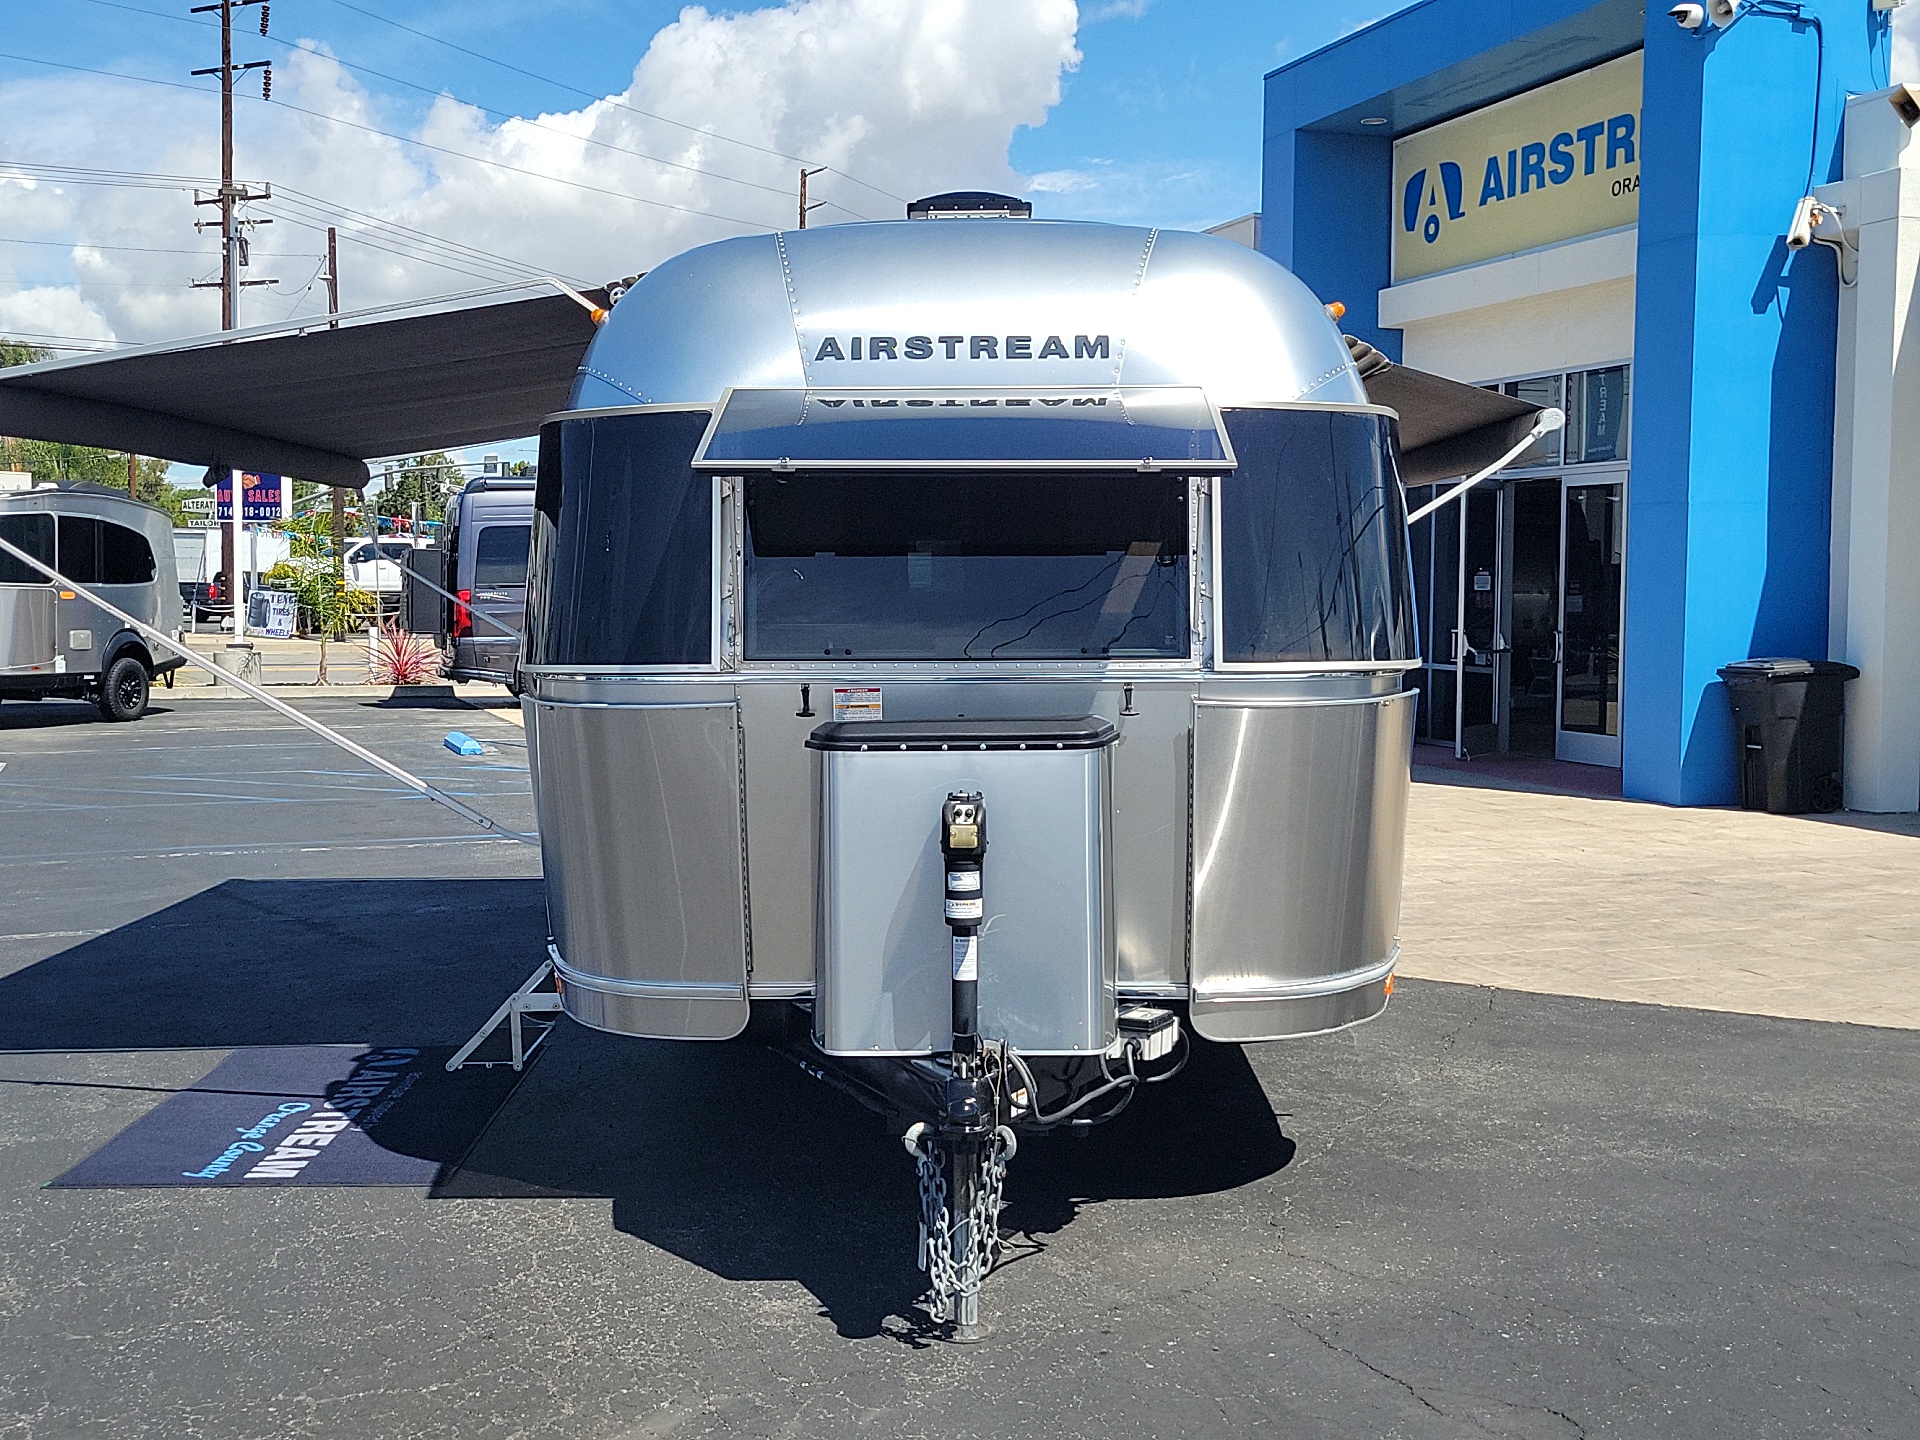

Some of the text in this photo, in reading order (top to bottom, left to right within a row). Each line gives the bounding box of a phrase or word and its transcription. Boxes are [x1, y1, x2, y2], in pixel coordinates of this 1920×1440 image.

[1479, 111, 1641, 207] AIRSTR
[814, 335, 1110, 361] AIRSTREAM
[248, 490, 280, 502] SALES
[273, 608, 290, 616] TIRES
[265, 628, 290, 637] WHEELS
[243, 1069, 400, 1179] AIRSTREAM
[182, 1102, 311, 1179] Orange County
